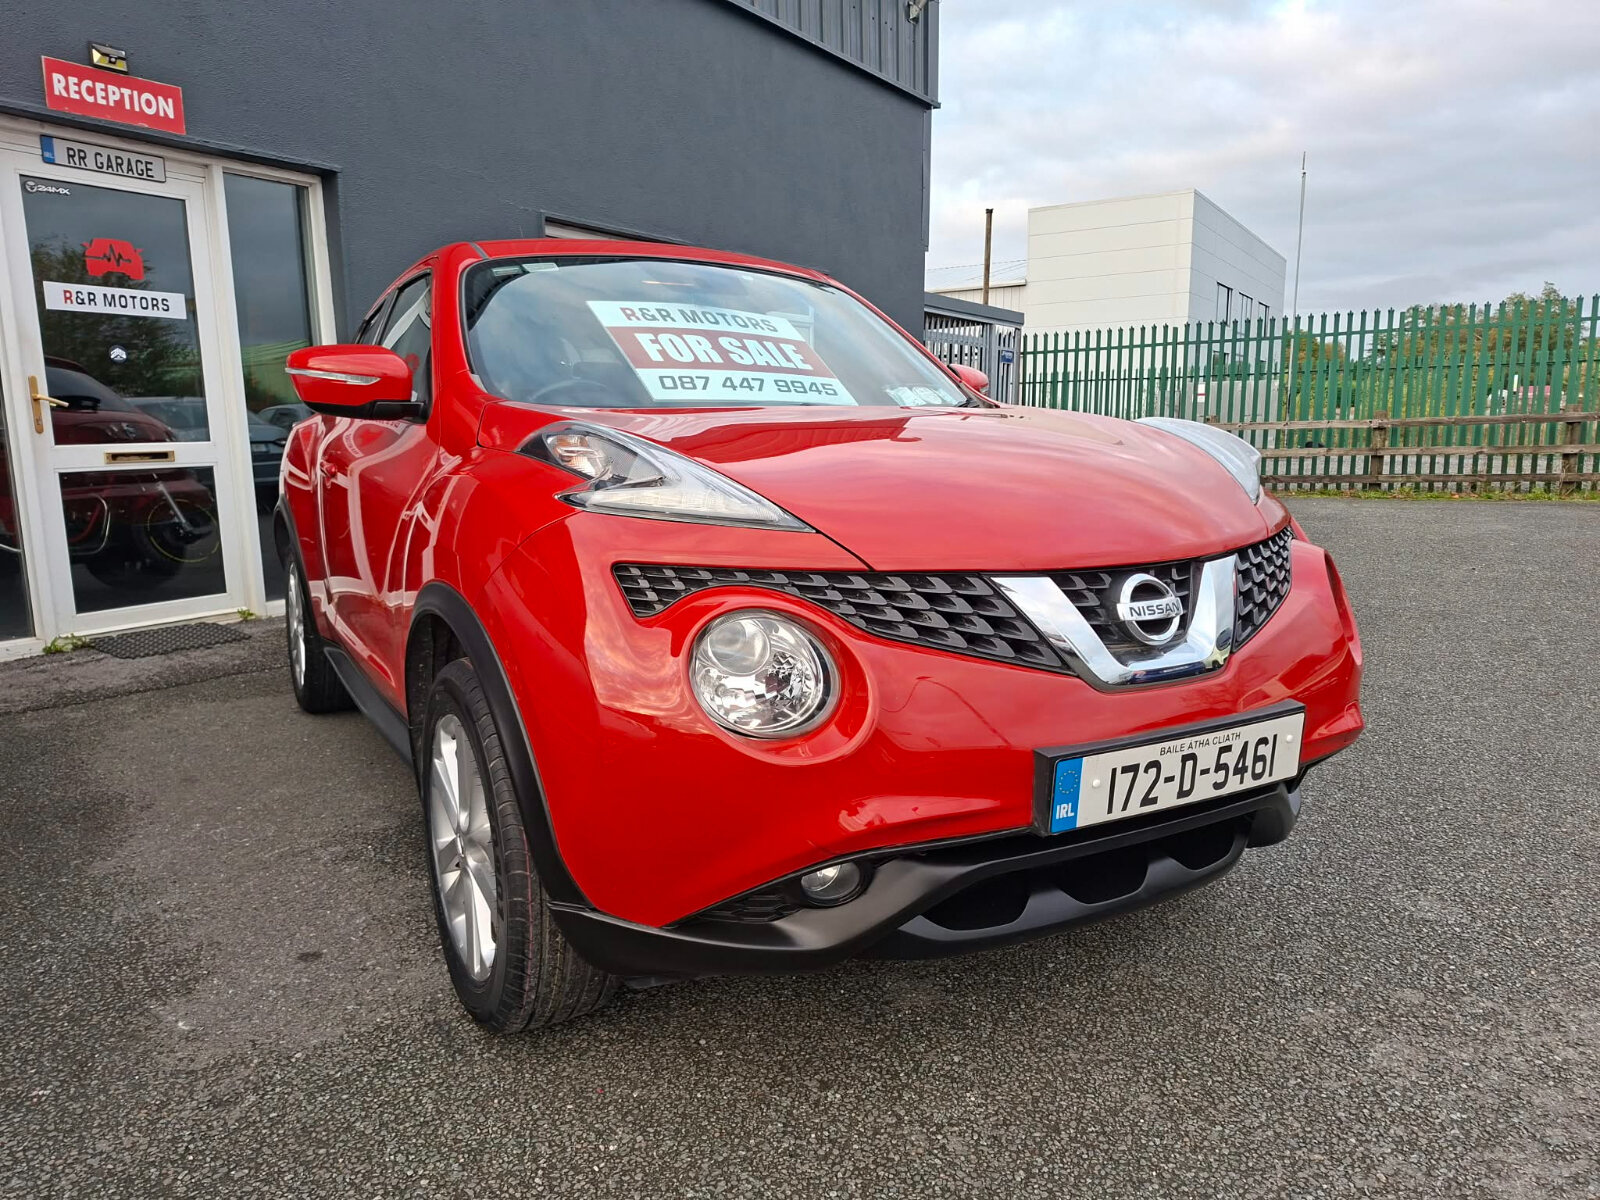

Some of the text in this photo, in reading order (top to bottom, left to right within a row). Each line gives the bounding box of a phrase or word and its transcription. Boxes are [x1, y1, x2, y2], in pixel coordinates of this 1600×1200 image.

[52, 72, 175, 119] RECEPTION
[66, 146, 155, 179] RR GARAGE
[63, 289, 170, 312] R&R MOTORS
[619, 307, 779, 333] R&R MOTORS
[634, 332, 814, 370] FOR SALE
[658, 375, 839, 397] 087 447 9945
[1129, 601, 1181, 617] NISSAN
[1159, 742, 1186, 756] BAILE
[1212, 732, 1242, 745] CLIATH
[1106, 733, 1278, 815] 172-D-5461
[1055, 802, 1075, 820] IRL
